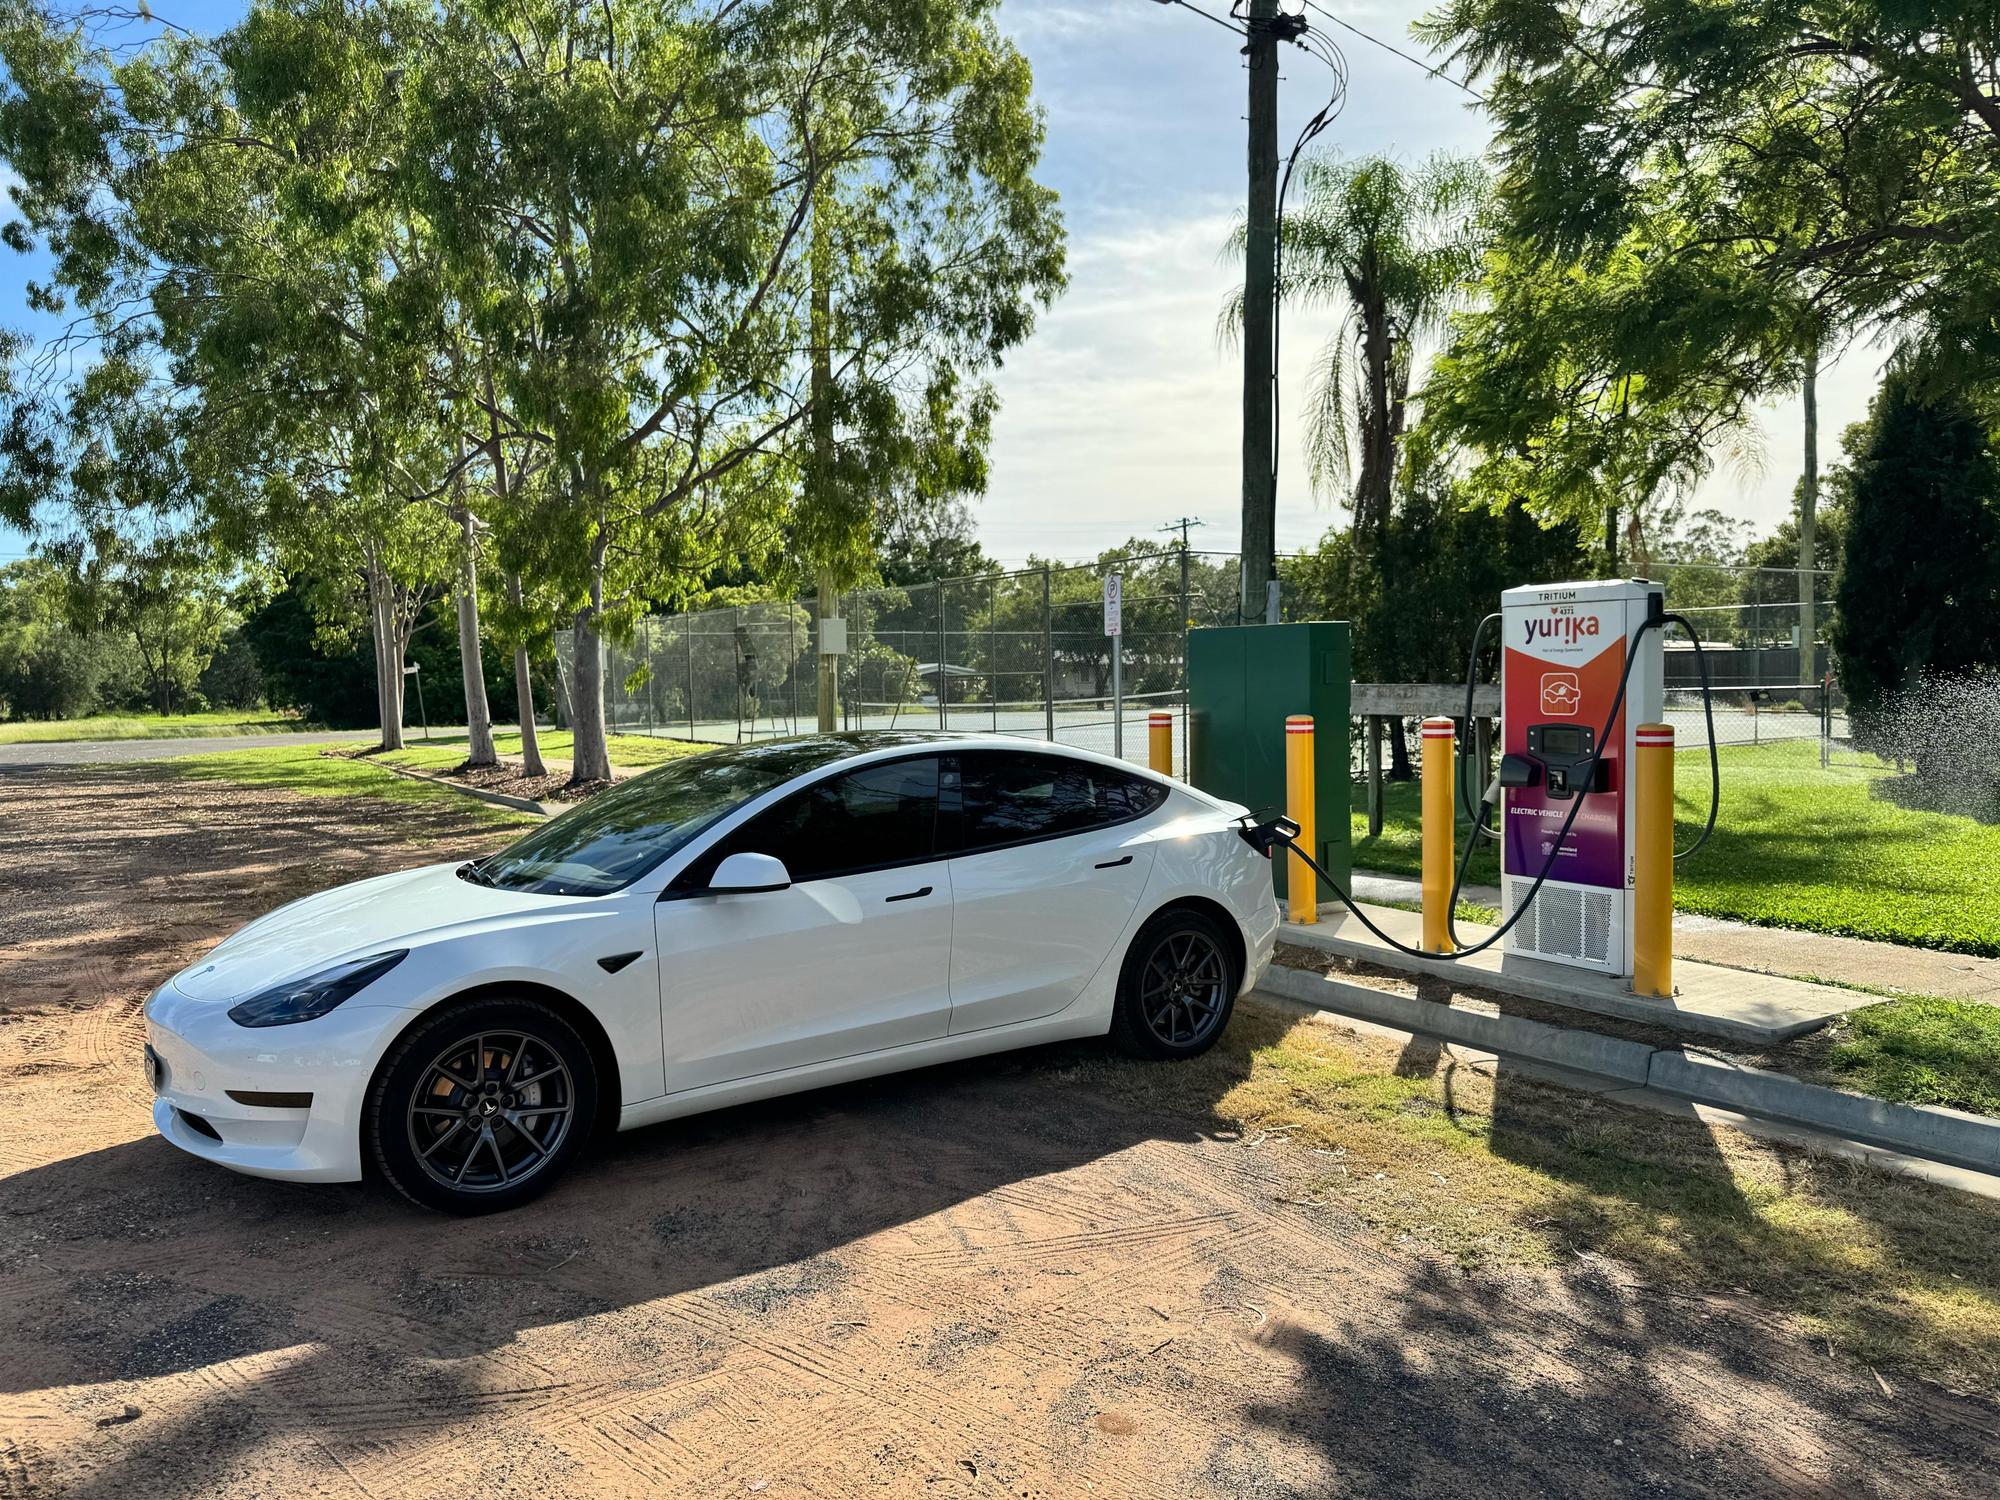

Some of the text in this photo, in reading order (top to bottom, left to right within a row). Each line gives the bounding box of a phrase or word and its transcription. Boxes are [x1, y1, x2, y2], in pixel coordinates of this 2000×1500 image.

[1538, 592, 1576, 601] TRITIUM
[1510, 807, 1538, 816] ELECTRIC
[1538, 809, 1564, 818] VEHICLE
